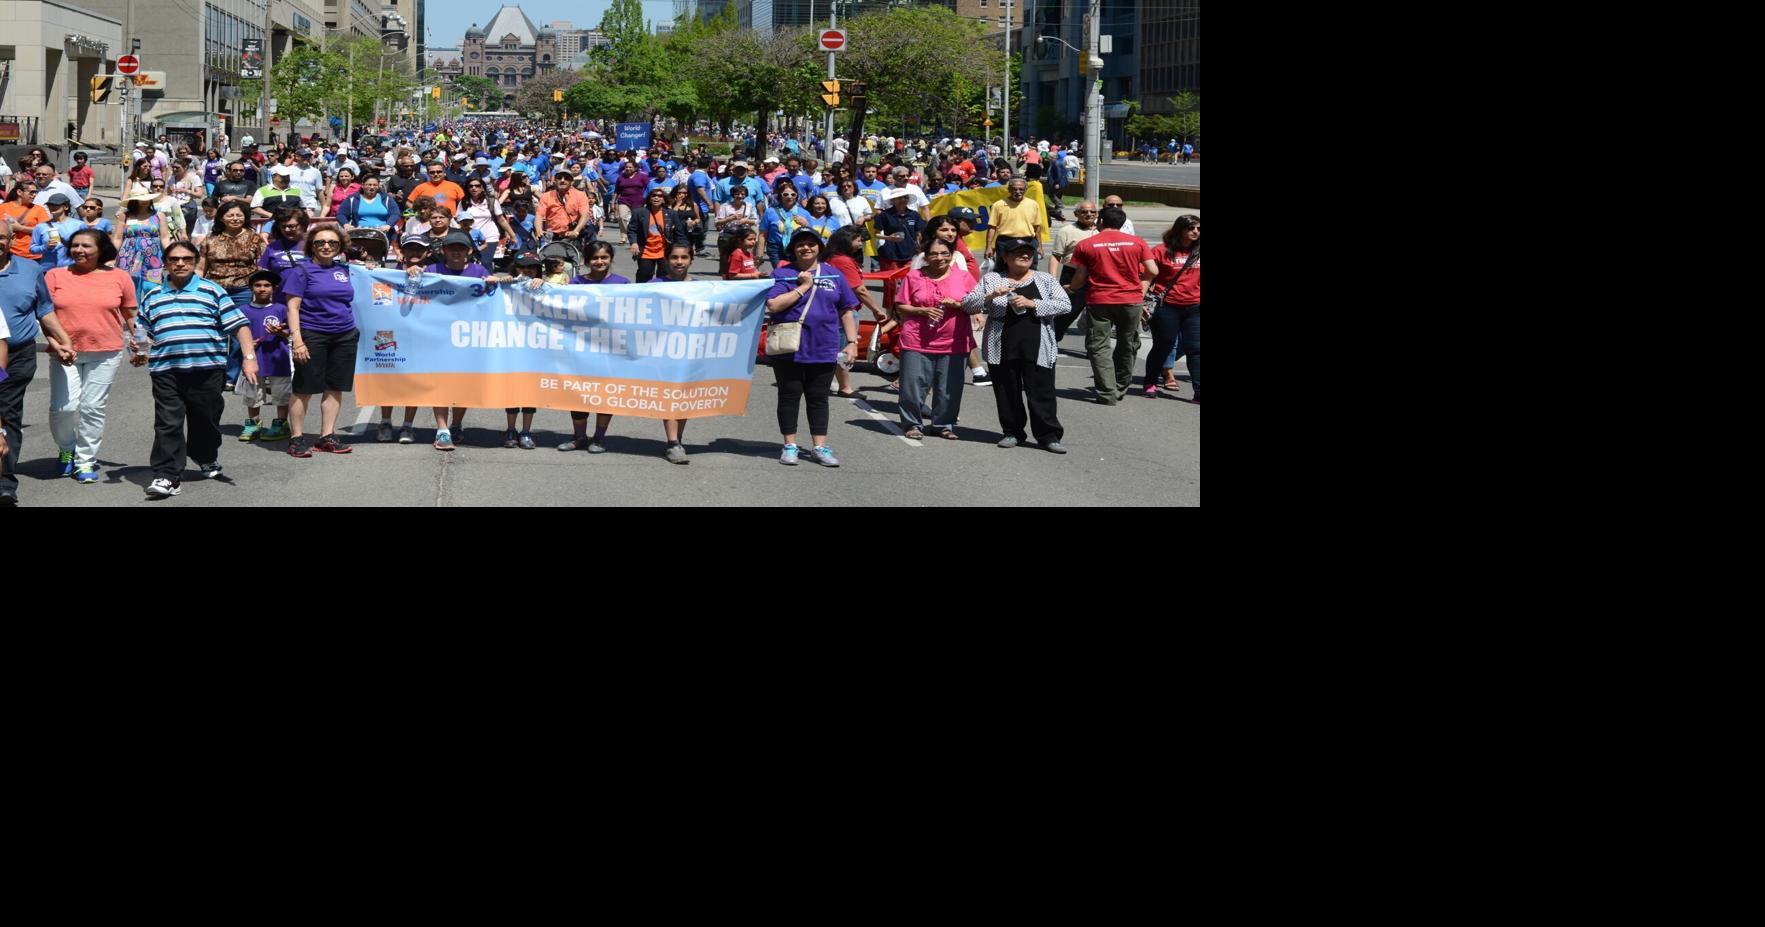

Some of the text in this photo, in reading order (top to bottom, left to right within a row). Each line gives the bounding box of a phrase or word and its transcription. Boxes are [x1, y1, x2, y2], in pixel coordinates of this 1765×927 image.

[504, 289, 749, 328] WALK THE WALK
[451, 321, 738, 360] CHANGE THE WORLD
[540, 378, 728, 400] BE PART OF THE SOLUTION
[580, 394, 728, 412] TO GLOBAL POVERTY
